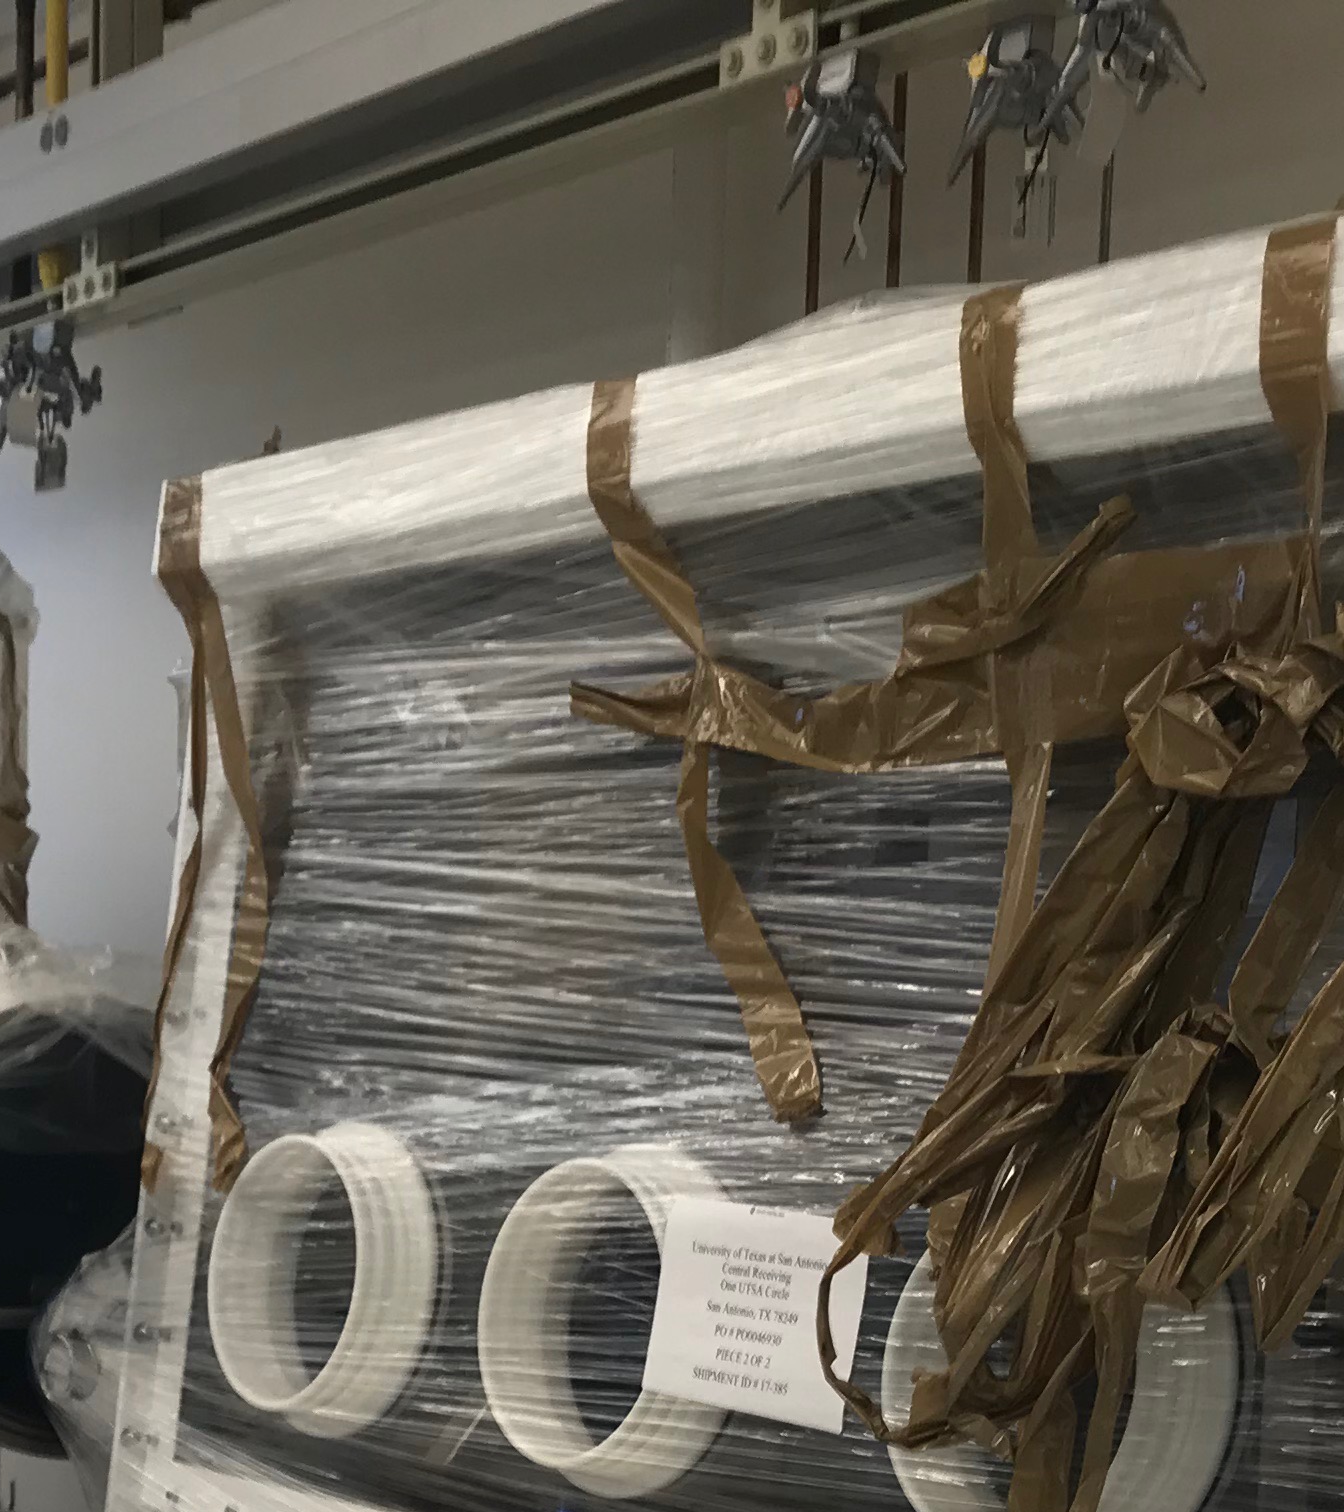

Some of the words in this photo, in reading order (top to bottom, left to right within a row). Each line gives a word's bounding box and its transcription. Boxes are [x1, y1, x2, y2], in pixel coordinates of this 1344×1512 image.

[692, 1240, 731, 1260] University
[732, 1247, 744, 1260] of
[743, 1248, 767, 1263] Texas
[767, 1253, 777, 1264] at
[777, 1252, 793, 1266] San
[794, 1256, 828, 1272] Antonio
[721, 1262, 751, 1278] Central
[752, 1267, 792, 1286] Receiving
[719, 1279, 737, 1292] One
[737, 1282, 763, 1297] UTSA
[764, 1286, 790, 1300] Circle
[706, 1300, 722, 1313] San
[722, 1302, 757, 1321] Antonio,
[758, 1308, 772, 1321] TX
[773, 1310, 799, 1325] 78249
[714, 1323, 729, 1337] PO
[716, 1347, 743, 1363] PIECE
[743, 1353, 750, 1365] 2
[750, 1354, 764, 1367] OF
[764, 1357, 771, 1369] 2
[692, 1365, 739, 1386] SHIPMENT
[740, 1374, 752, 1388] ID
